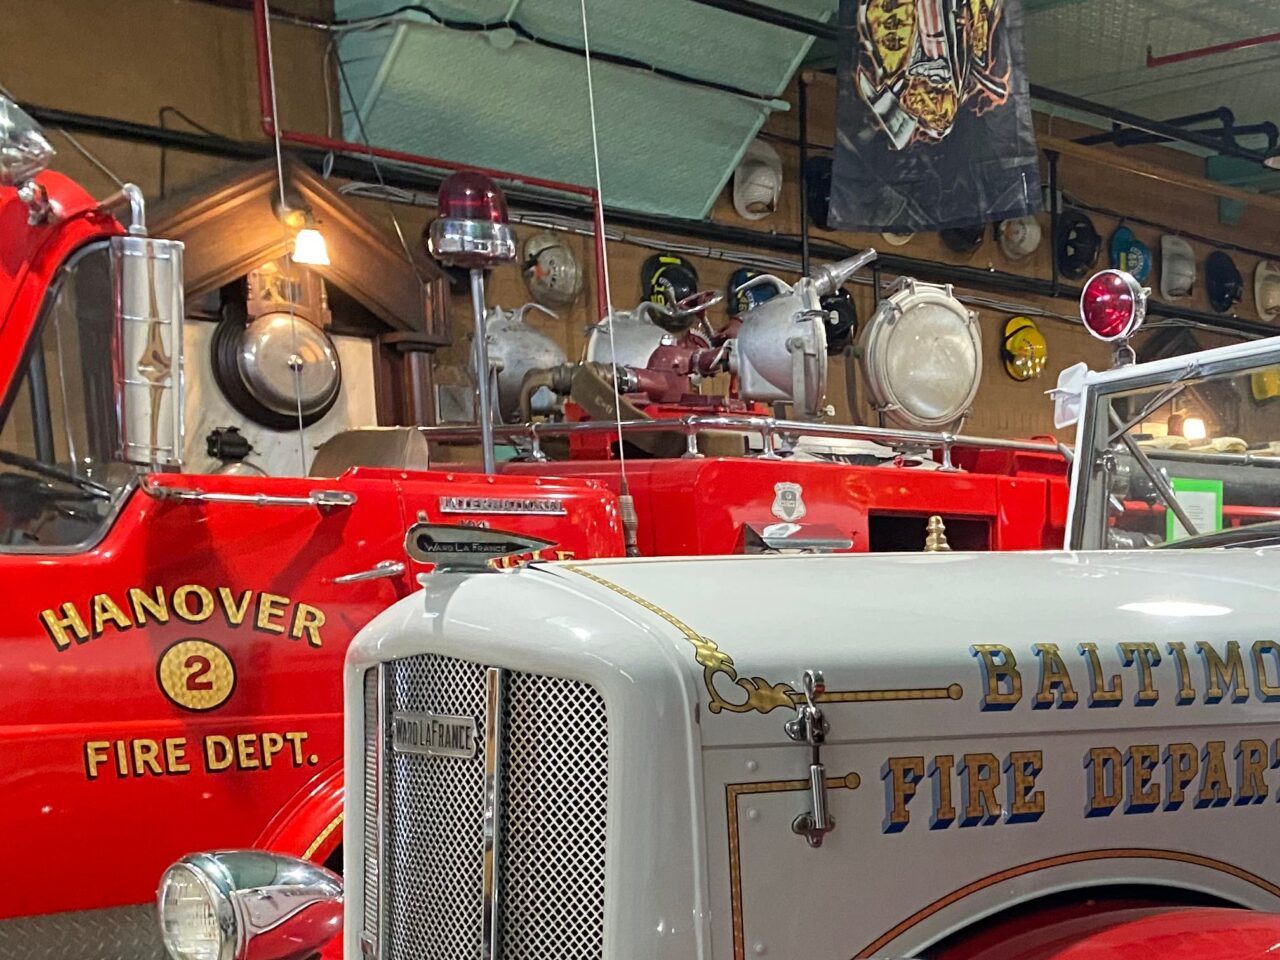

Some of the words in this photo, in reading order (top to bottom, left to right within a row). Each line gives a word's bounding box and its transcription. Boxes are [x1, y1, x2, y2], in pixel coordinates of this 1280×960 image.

[39, 584, 326, 650] HANOVER
[183, 655, 213, 691] 2
[84, 737, 191, 780] FIRE
[203, 731, 319, 773] DEPT.
[882, 749, 1046, 833] FIRE
